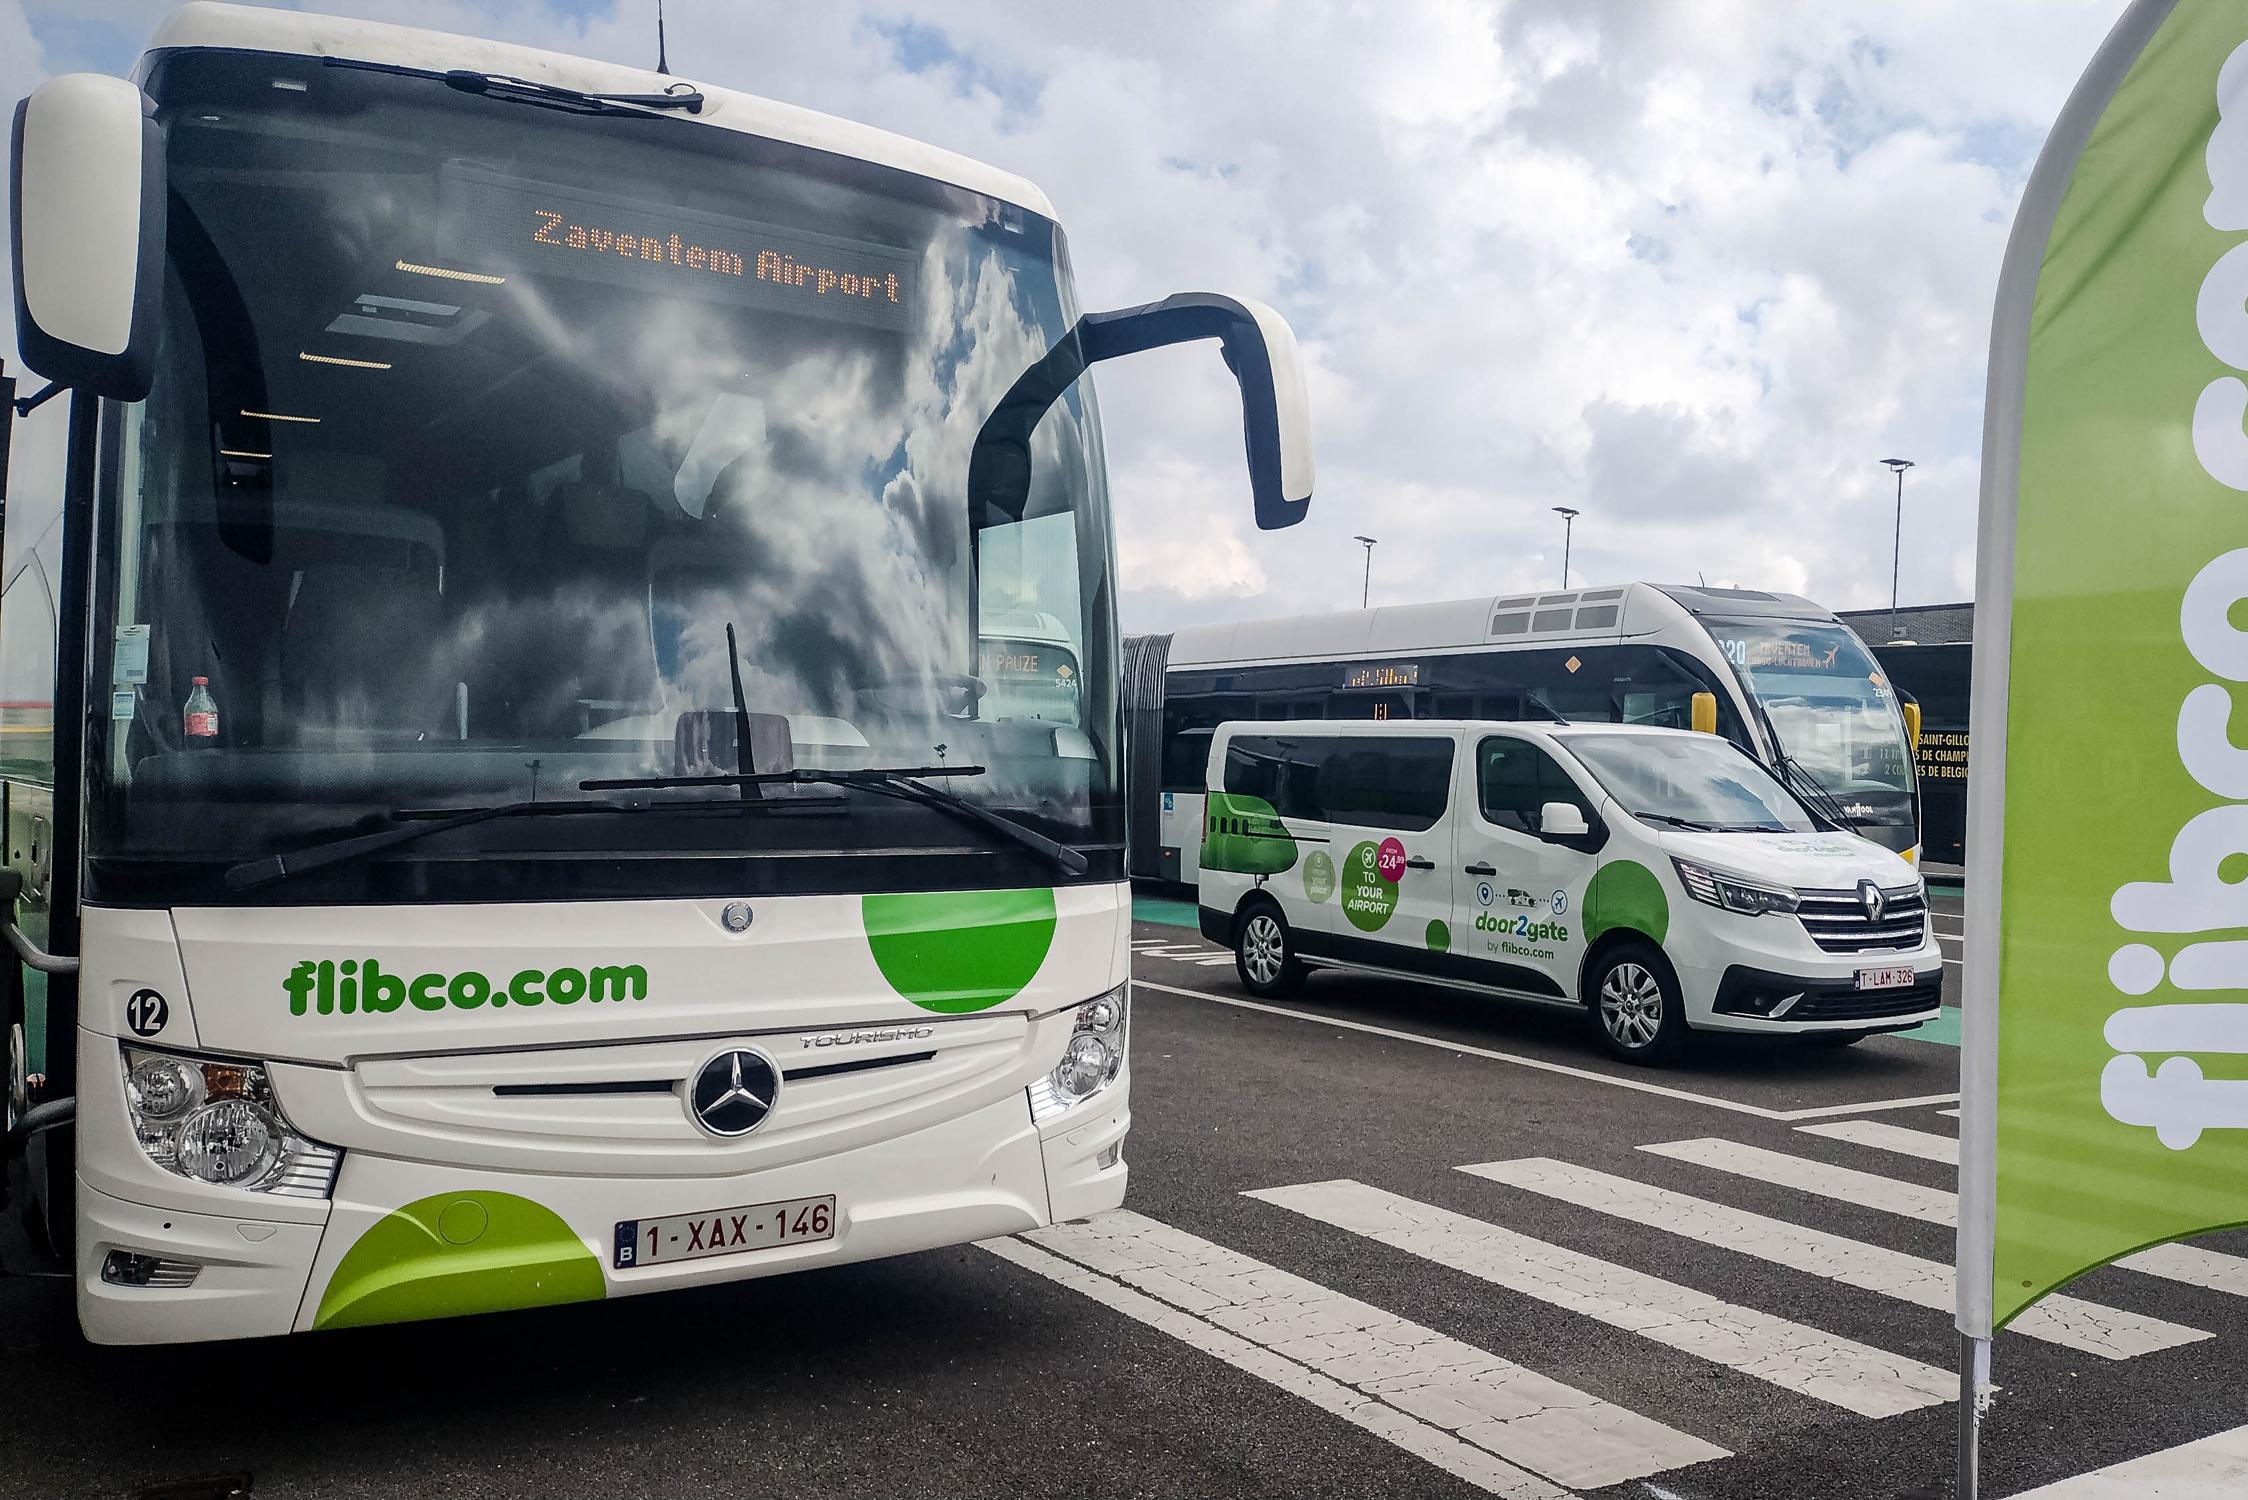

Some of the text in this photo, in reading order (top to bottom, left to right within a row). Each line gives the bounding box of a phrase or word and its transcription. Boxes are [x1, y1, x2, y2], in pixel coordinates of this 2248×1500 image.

[534, 210, 900, 303] Zaventem Airport
[2100, 38, 2248, 1150] flibco
[997, 654, 1038, 672] PAUZE
[1055, 679, 1078, 688] 5424
[1922, 750, 1933, 761] DE
[1928, 765, 1939, 777] DE
[1363, 871, 1376, 884] TO
[1356, 884, 1383, 899] YOUR
[1347, 899, 1390, 915] AIRPORT
[1475, 911, 1569, 943] door2gate
[1487, 939, 1554, 959] by flibco.com
[281, 958, 649, 1017] flibco.com
[131, 995, 162, 1031] 12
[800, 1026, 934, 1049] TOURISMO
[620, 1246, 633, 1262] B
